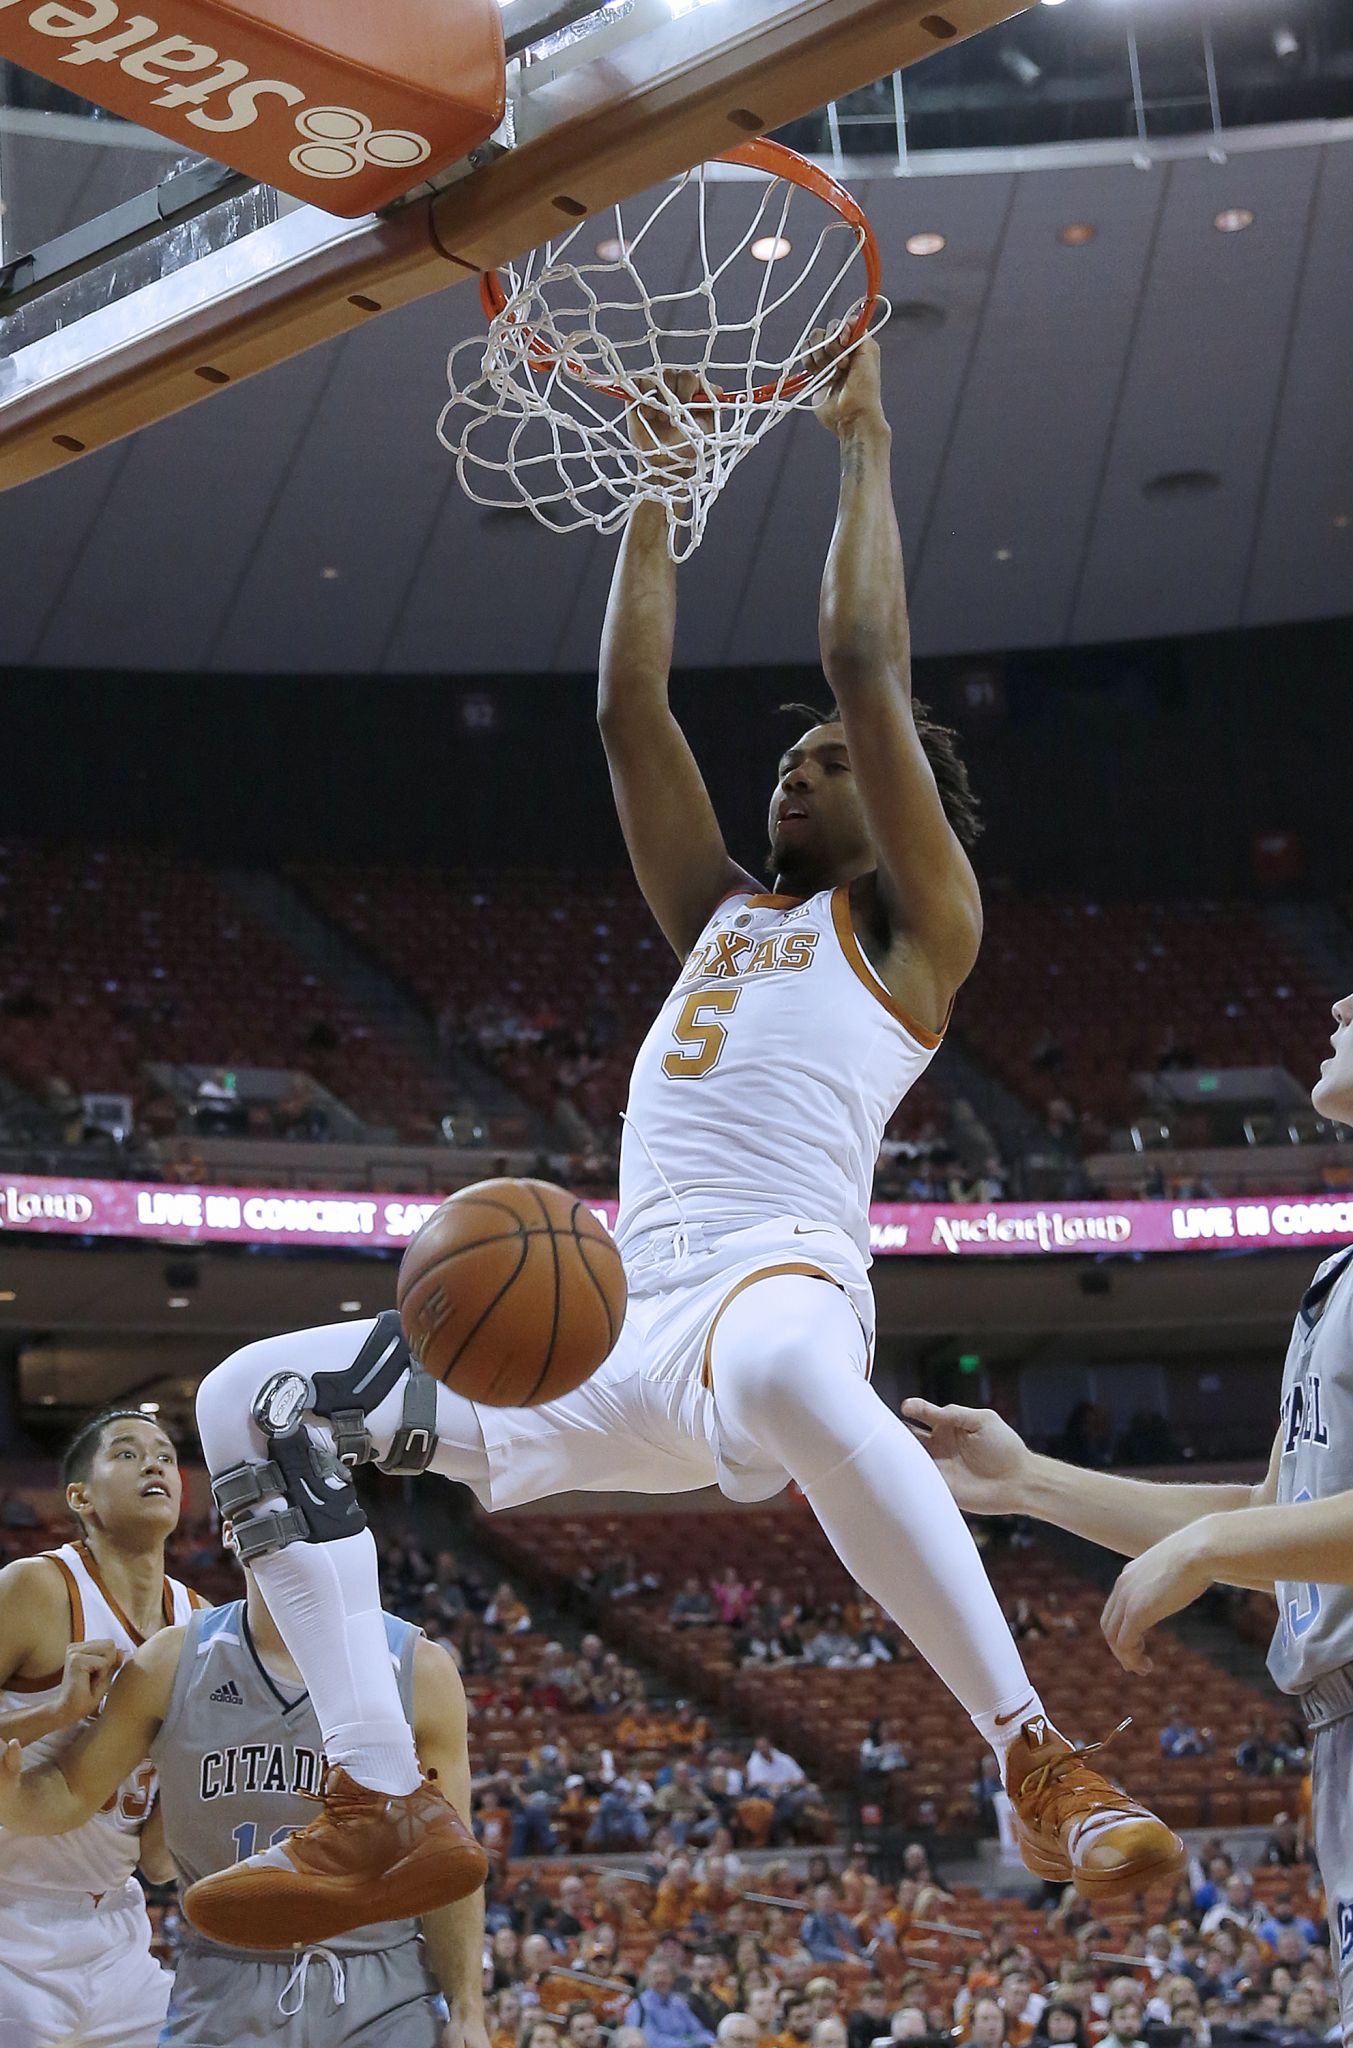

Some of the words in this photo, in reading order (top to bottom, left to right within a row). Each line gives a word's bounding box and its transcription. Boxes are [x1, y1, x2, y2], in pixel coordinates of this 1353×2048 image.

[28, 0, 305, 132] State
[661, 987, 742, 1080] 5
[137, 1192, 203, 1226] LIVE
[205, 1196, 241, 1228] IN
[243, 1197, 378, 1234] CONCERT
[1172, 1208, 1235, 1239] LIVE
[1236, 1205, 1270, 1236] IN
[1272, 1202, 1353, 1235] CONC
[209, 1693, 243, 1705] adidas
